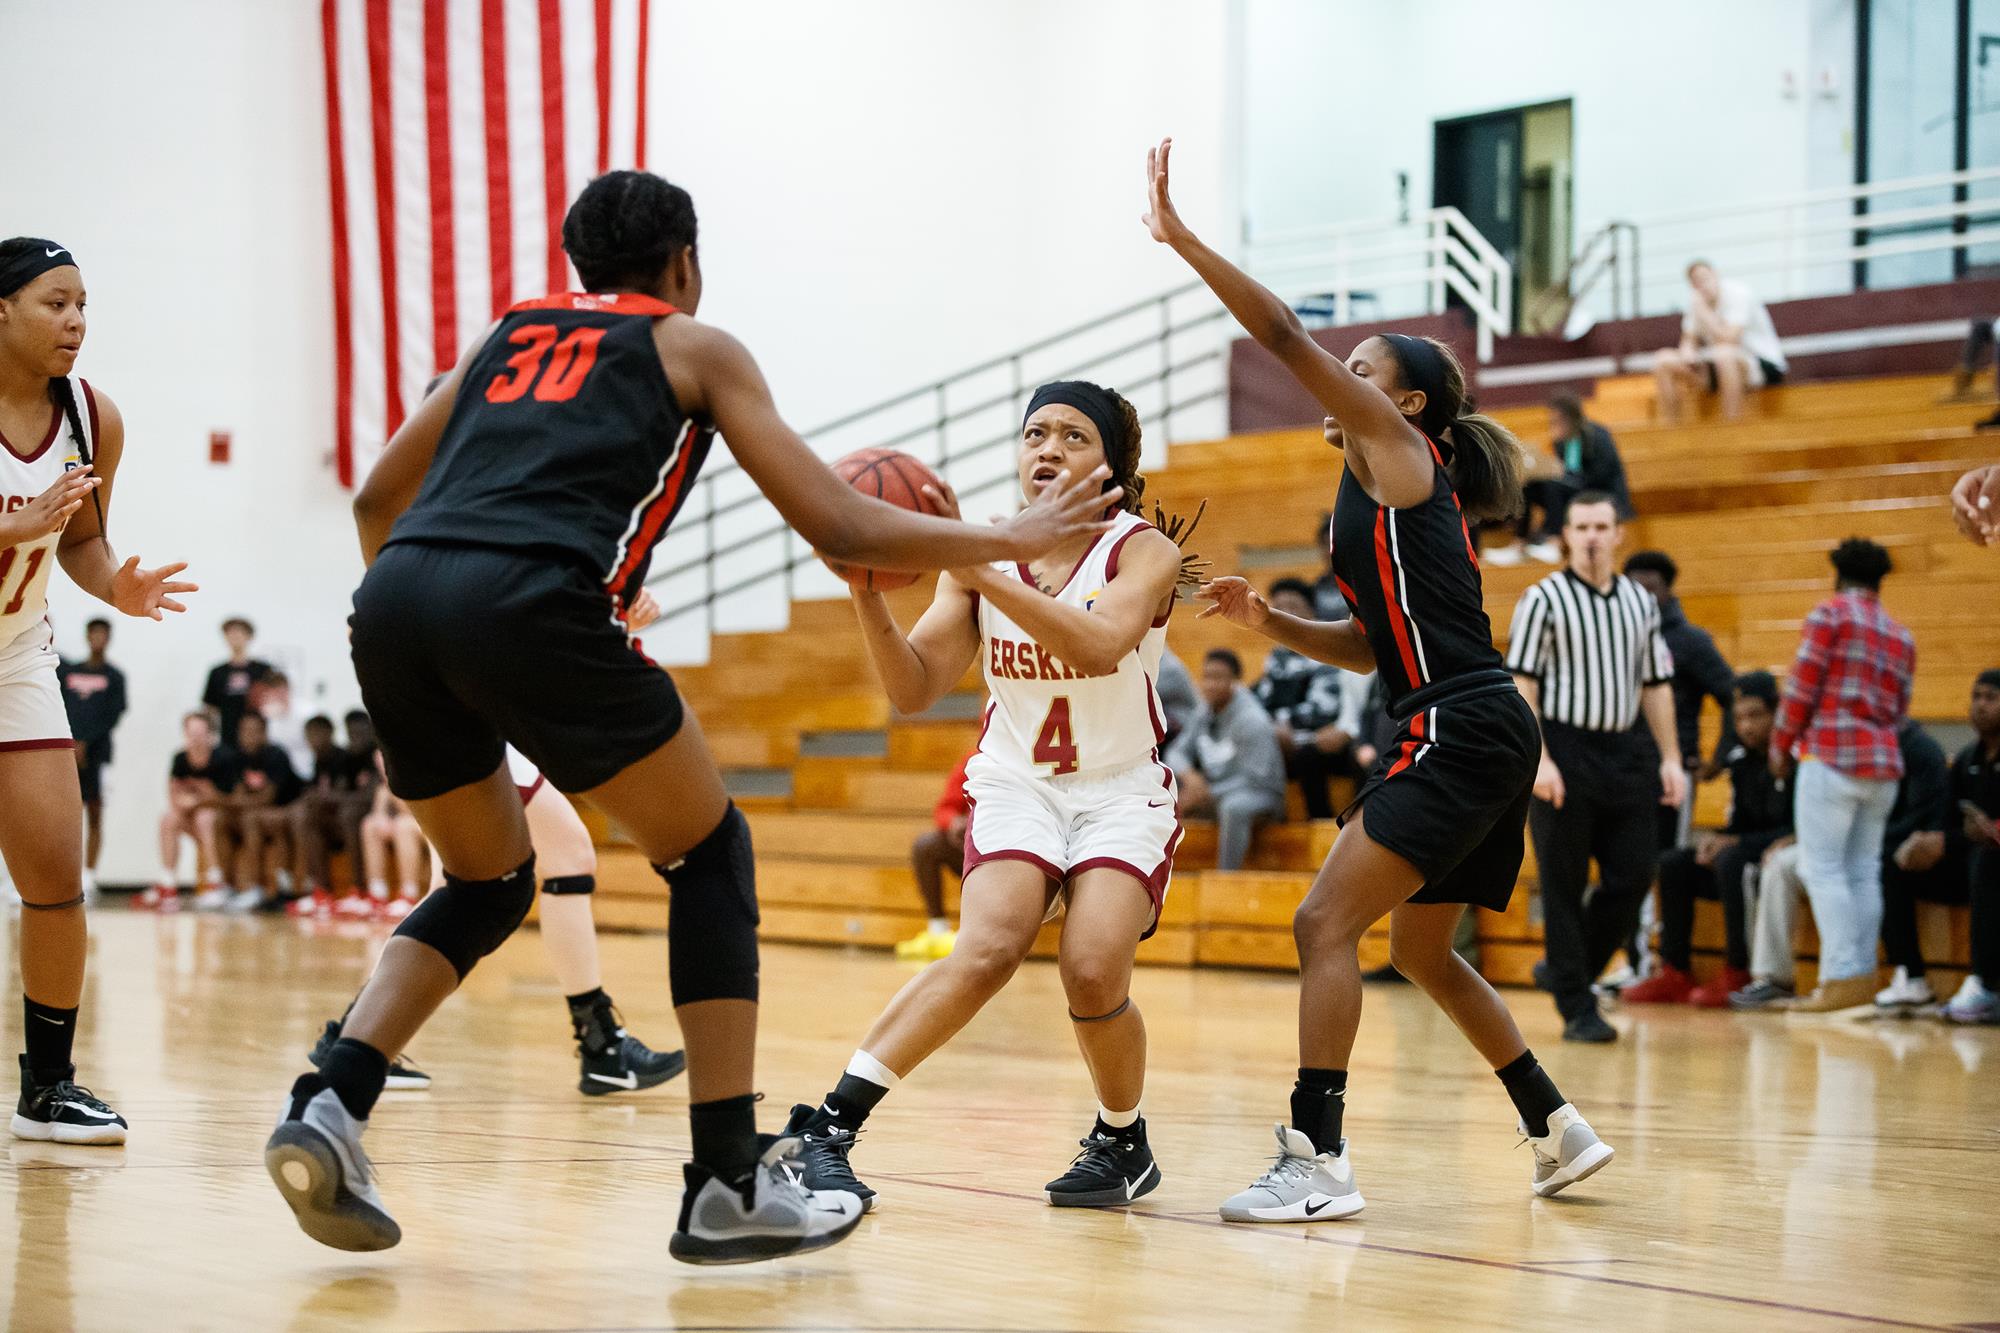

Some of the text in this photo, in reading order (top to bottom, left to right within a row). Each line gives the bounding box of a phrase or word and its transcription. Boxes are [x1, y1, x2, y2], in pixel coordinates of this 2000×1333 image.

[484, 324, 608, 404] 30
[990, 636, 1119, 680] ERSK
[1032, 695, 1080, 776] 4
